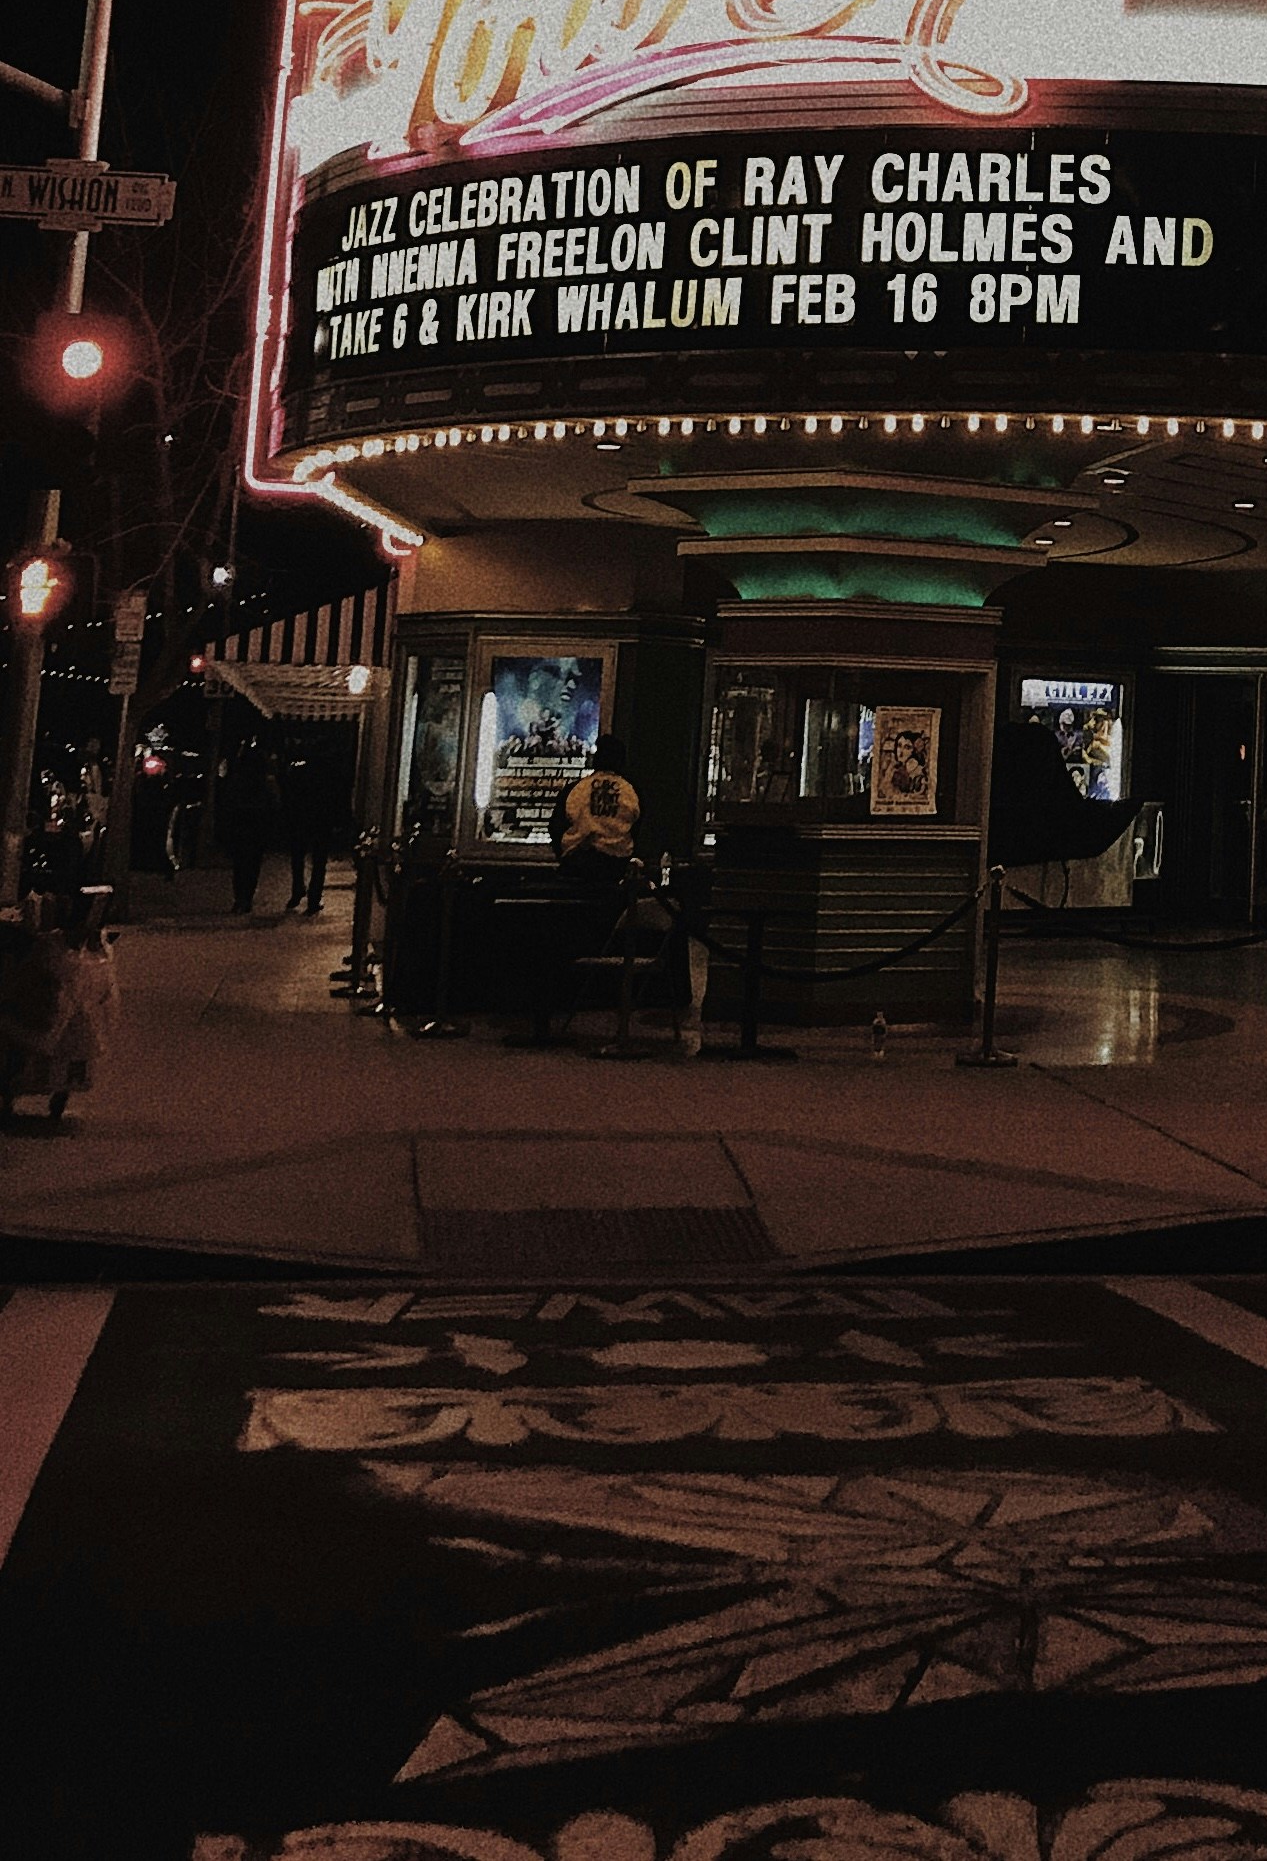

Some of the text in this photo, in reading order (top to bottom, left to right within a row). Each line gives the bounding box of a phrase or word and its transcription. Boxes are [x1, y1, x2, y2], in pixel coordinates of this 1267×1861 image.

[28, 174, 119, 213] WISHON
[341, 152, 1111, 251] JAZZ CELEBRATION OF RAY CHARLES
[316, 212, 1214, 313] WITH NNENNA FREELON CLINT HOLMES AND
[329, 273, 1081, 360] TAKE 6 & KIRK WHALUM FEB 16 8PM
